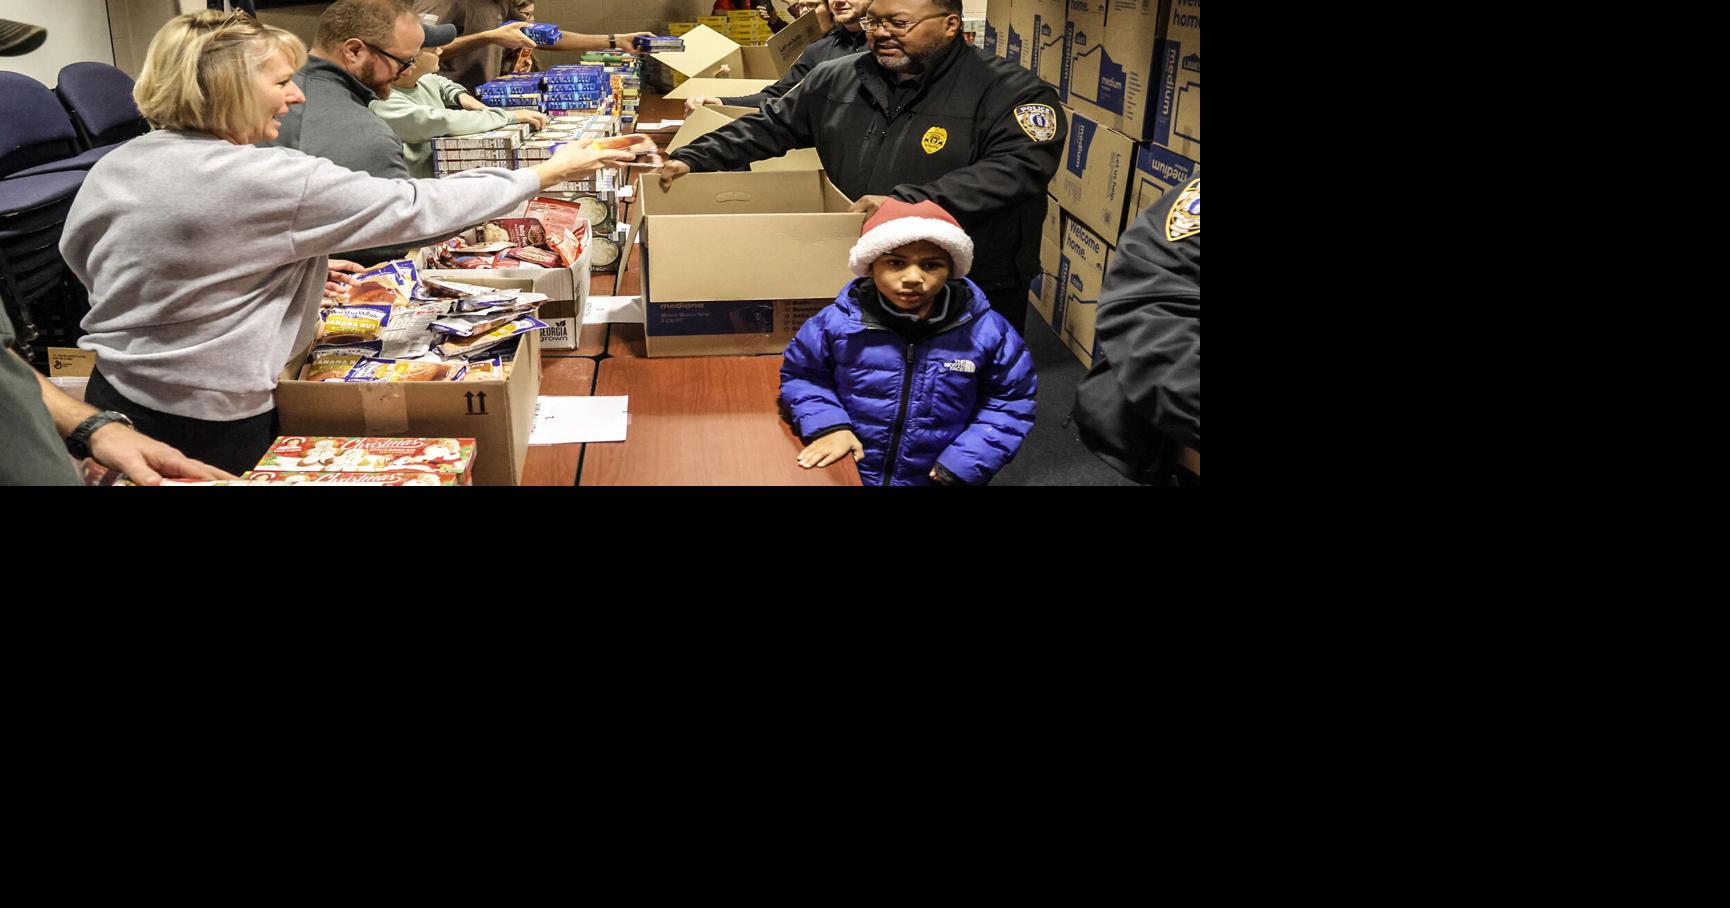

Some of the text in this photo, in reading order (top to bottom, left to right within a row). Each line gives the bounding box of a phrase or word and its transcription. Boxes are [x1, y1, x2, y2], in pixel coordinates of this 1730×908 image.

[1172, 8, 1200, 28] hom
[1162, 49, 1176, 115] medium
[1020, 105, 1050, 113] POLICE
[1151, 159, 1188, 183] medium
[1067, 235, 1087, 261] home.
[1070, 221, 1100, 254] Welcome
[341, 437, 423, 450] Christmas
[316, 472, 401, 483] Christmas
